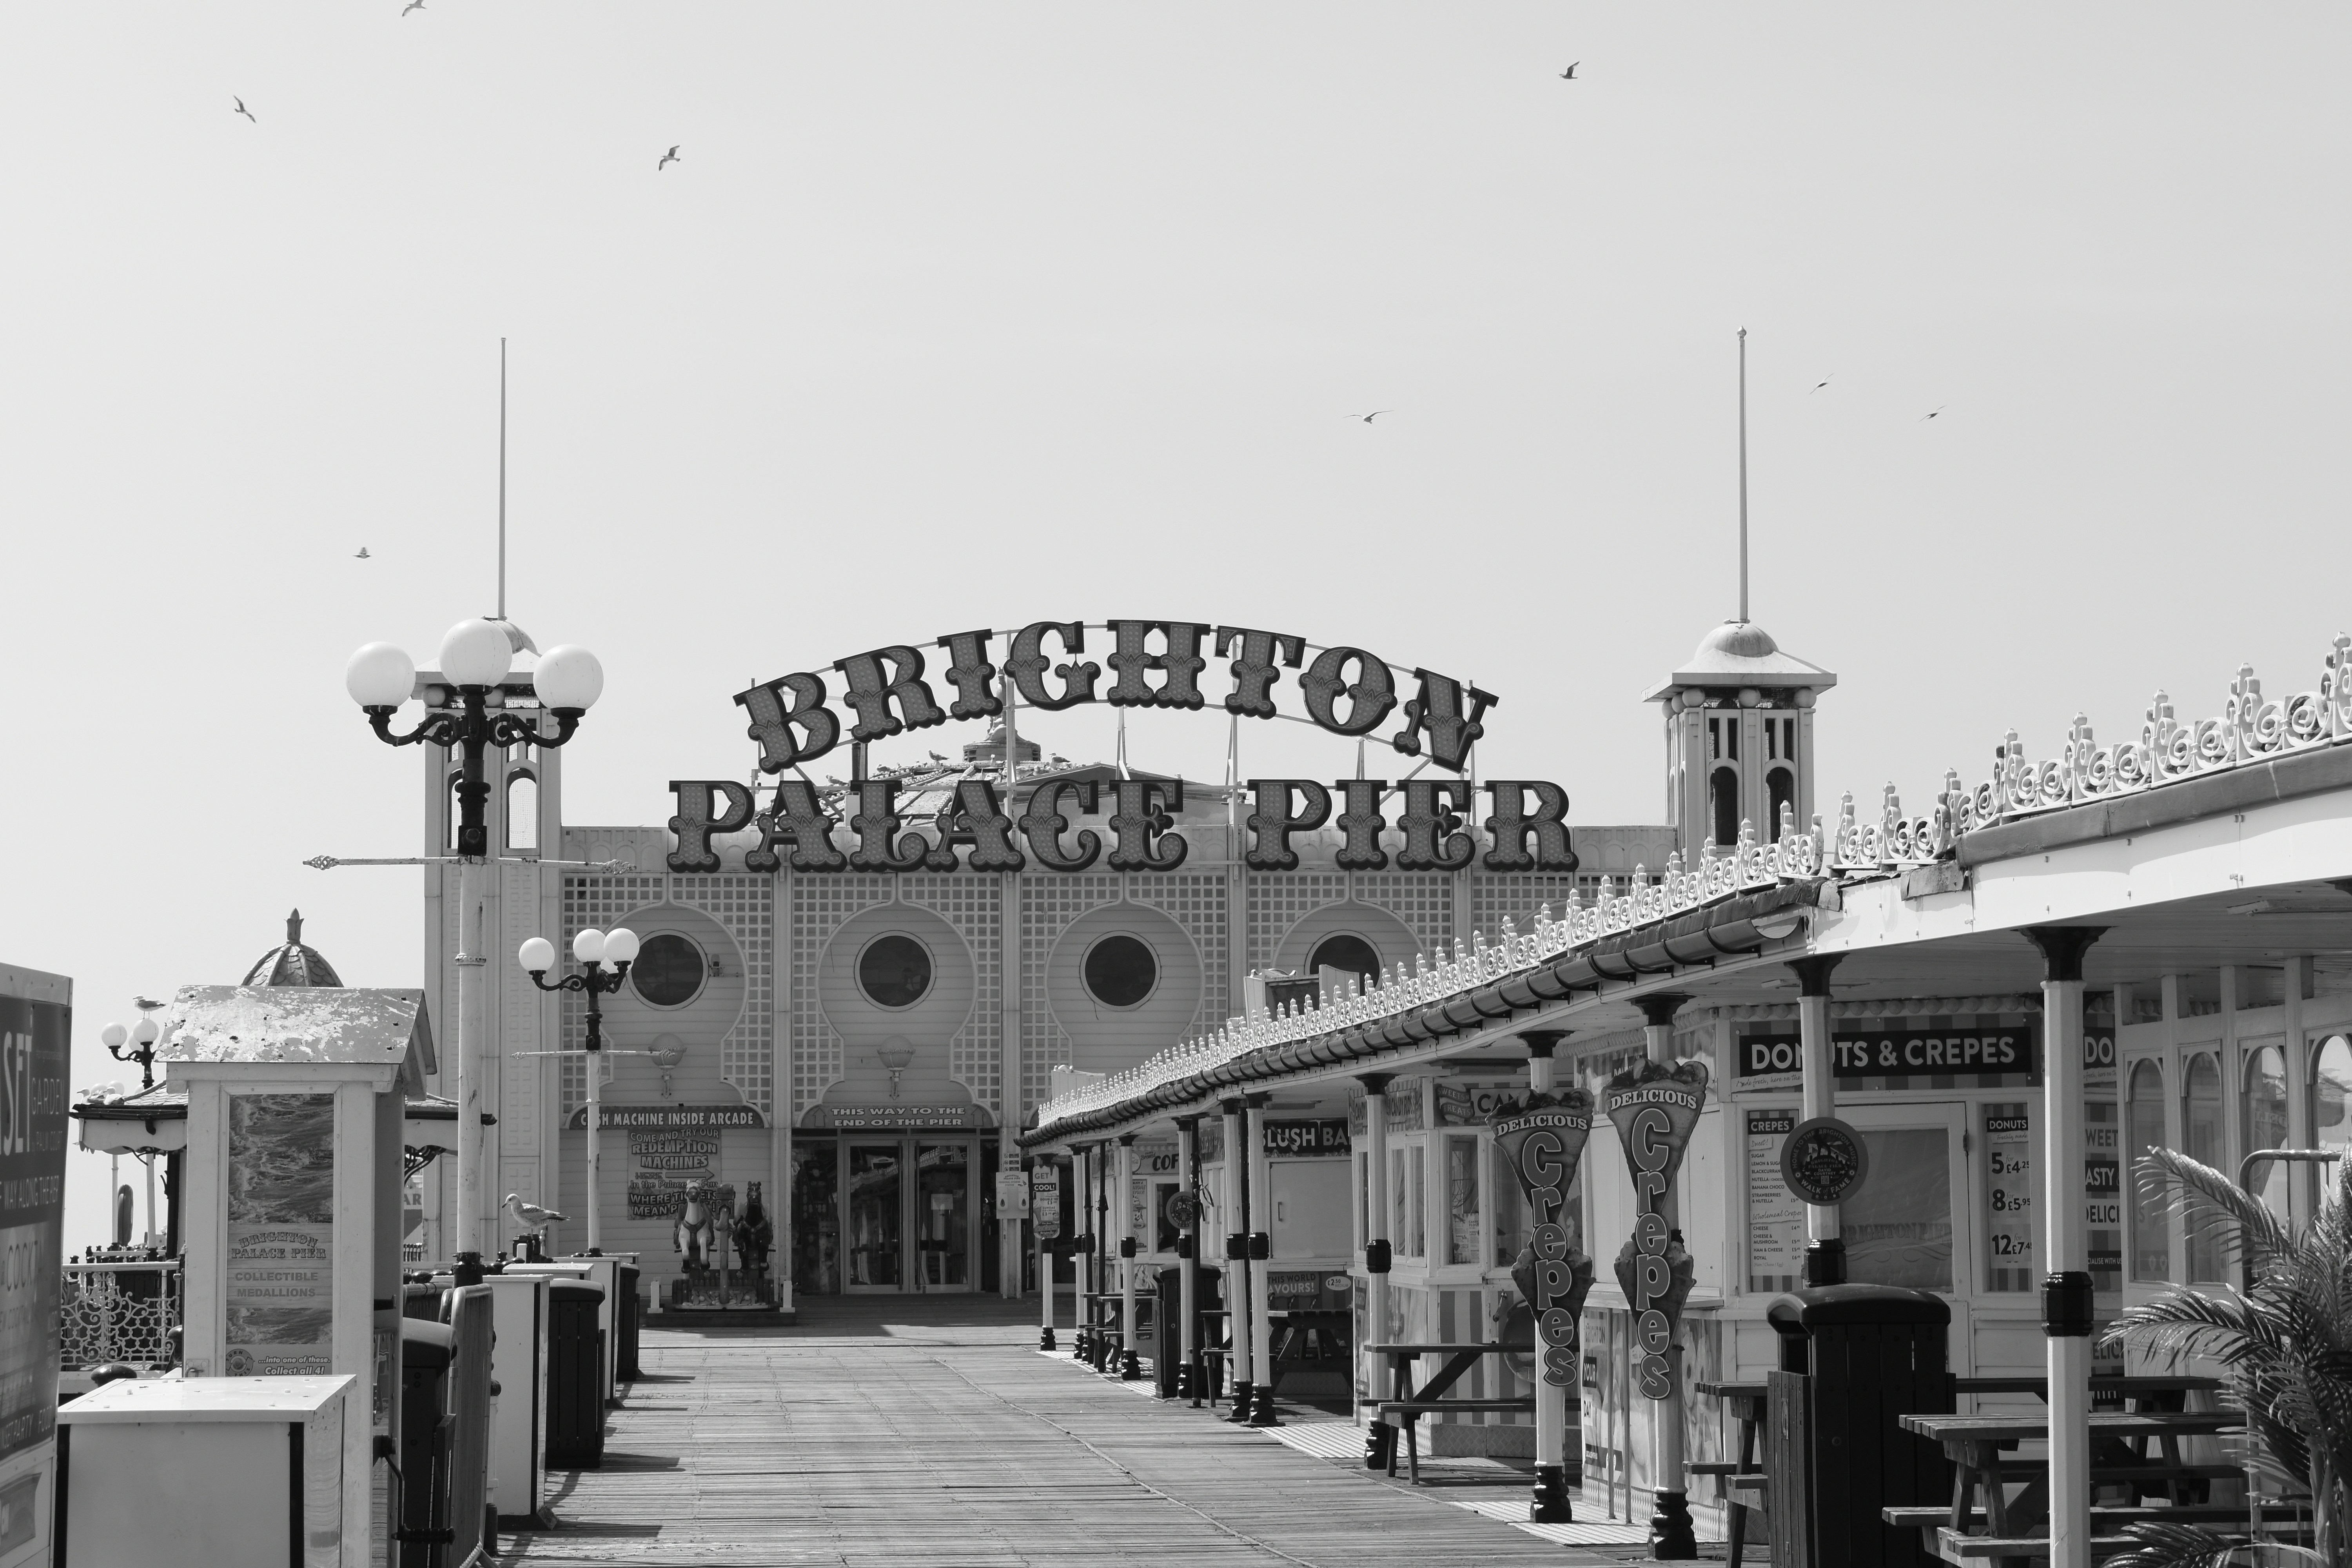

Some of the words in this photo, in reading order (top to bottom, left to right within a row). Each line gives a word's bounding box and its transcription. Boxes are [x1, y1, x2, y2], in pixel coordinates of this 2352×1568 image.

[733, 619, 1499, 775] BRIGHTON
[667, 778, 1189, 873] PALACE
[1246, 778, 1579, 873] PIER
[1752, 1041, 1868, 1069] DOTS
[1879, 1040, 1897, 1066] &
[1905, 1036, 2015, 1065] CREPES
[2084, 1036, 2116, 1063] DO
[1753, 1078, 1769, 1088] fresh,
[0, 1031, 32, 1156] SET
[32, 1077, 64, 1115] GARDEN
[1437, 1088, 1465, 1100] SWEETS
[1611, 1089, 1697, 1111] DELICIOUS
[581, 1113, 608, 1126] CH
[613, 1112, 664, 1126] MACHINE
[668, 1112, 705, 1125] INSIDE
[709, 1112, 754, 1125] ARCADE
[1497, 1114, 1587, 1136] DELICIOUS
[1751, 1121, 1789, 1132] CREPES
[1989, 1120, 2027, 1129] DONUTS
[630, 1132, 656, 1142] COME
[659, 1131, 678, 1142] AND
[680, 1129, 697, 1138] TRY
[699, 1128, 719, 1139] OUR
[1323, 1127, 1351, 1146] BA
[1751, 1138, 1769, 1147] Sweet!
[1996, 1133, 2014, 1142] Freshly
[2085, 1129, 2118, 1147] WEET
[632, 1140, 717, 1154] REDEMPTION
[1798, 1139, 1804, 1148] TO
[1803, 1130, 1816, 1141] THE
[1818, 1129, 1851, 1145] BRIGHTON
[1848, 1145, 1857, 1167] MUSIC
[640, 1155, 709, 1170] MACHINES
[1152, 1154, 1179, 1171] COF
[1991, 1152, 2004, 1174] 5
[2005, 1154, 2014, 1165] for
[630, 1180, 640, 1189] In
[641, 1180, 656, 1189] the
[658, 1180, 686, 1189] Palace
[701, 1179, 719, 1188] Fun
[2085, 1167, 2114, 1186] ASTY
[4, 1180, 18, 1210] WAY
[18, 1177, 38, 1209] ALONG
[39, 1176, 49, 1205] THE
[1801, 1179, 1822, 1194] WALK
[1830, 1177, 1851, 1193] FAME
[629, 1192, 671, 1205] WHERE
[1992, 1189, 2007, 1212] 8
[2005, 1191, 2015, 1201] for
[2008, 1197, 2031, 1211] £5.95
[633, 1205, 668, 1216] MEAN
[1753, 1209, 1783, 1220] Wholemeal
[238, 1231, 319, 1248] BRIGHTON
[1992, 1234, 2012, 1255] 12
[2013, 1233, 2023, 1243] for
[231, 1248, 286, 1259] PALACE
[291, 1248, 327, 1258] PIER
[1523, 1132, 1577, 1386] Crepes
[1632, 1108, 1671, 1399] Crepes
[235, 1272, 318, 1281] COLLECTIBLE
[1267, 1276, 1285, 1285] THIS
[1287, 1274, 1316, 1282] WORLD
[237, 1288, 316, 1297] MEDALLIONS
[1267, 1282, 1314, 1294] AVOURS!
[226, 1350, 243, 1361] TURN
[259, 1356, 281, 1364] ...Into
[298, 1355, 309, 1363] of
[308, 1355, 332, 1363] these.
[265, 1366, 298, 1375] Collect
[299, 1366, 312, 1375] all
[314, 1366, 325, 1375] 4!
[1584, 1362, 1596, 1382] YOUR
[1584, 1402, 1592, 1418] DAY
